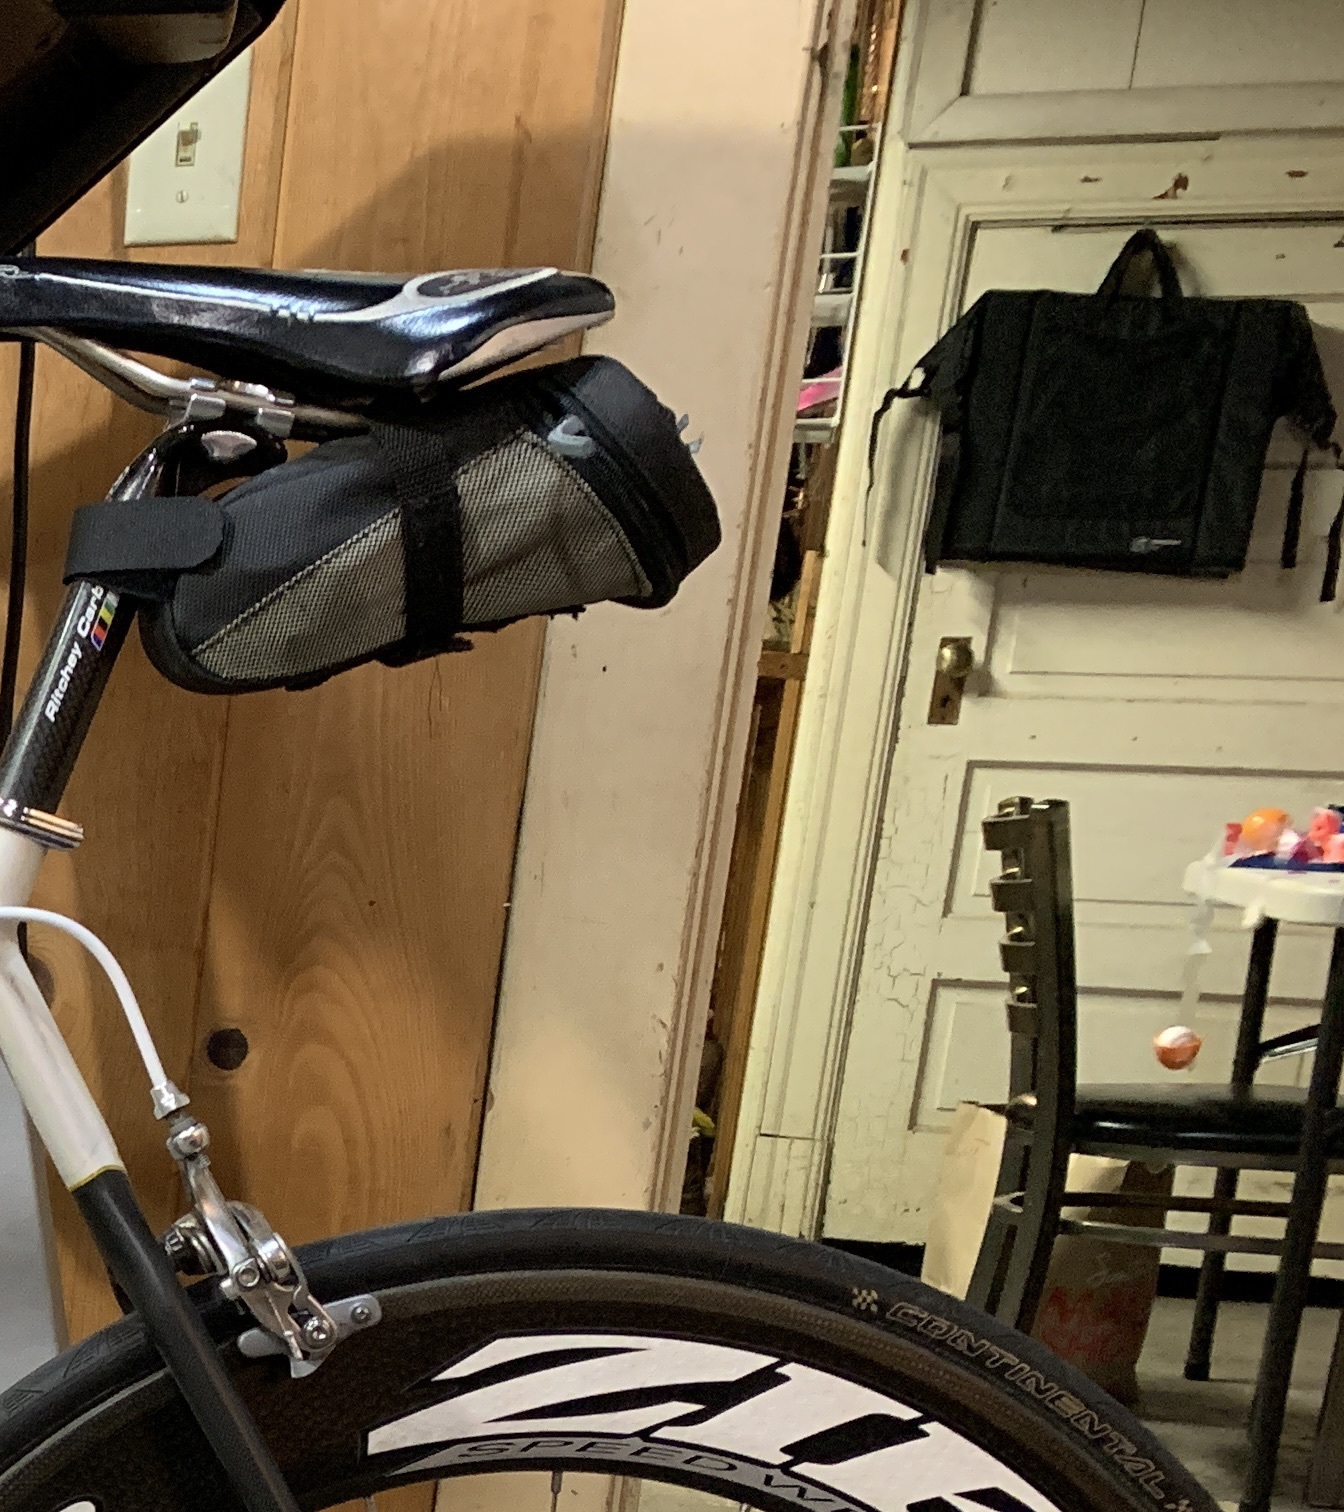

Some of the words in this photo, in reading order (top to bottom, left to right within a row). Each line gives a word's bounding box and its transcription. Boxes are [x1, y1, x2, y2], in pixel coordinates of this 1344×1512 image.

[45, 642, 83, 723] Ritchey
[76, 585, 105, 639] Carb
[456, 1438, 737, 1478] SPEED
[888, 1300, 1169, 1504] CONTINENTAL
